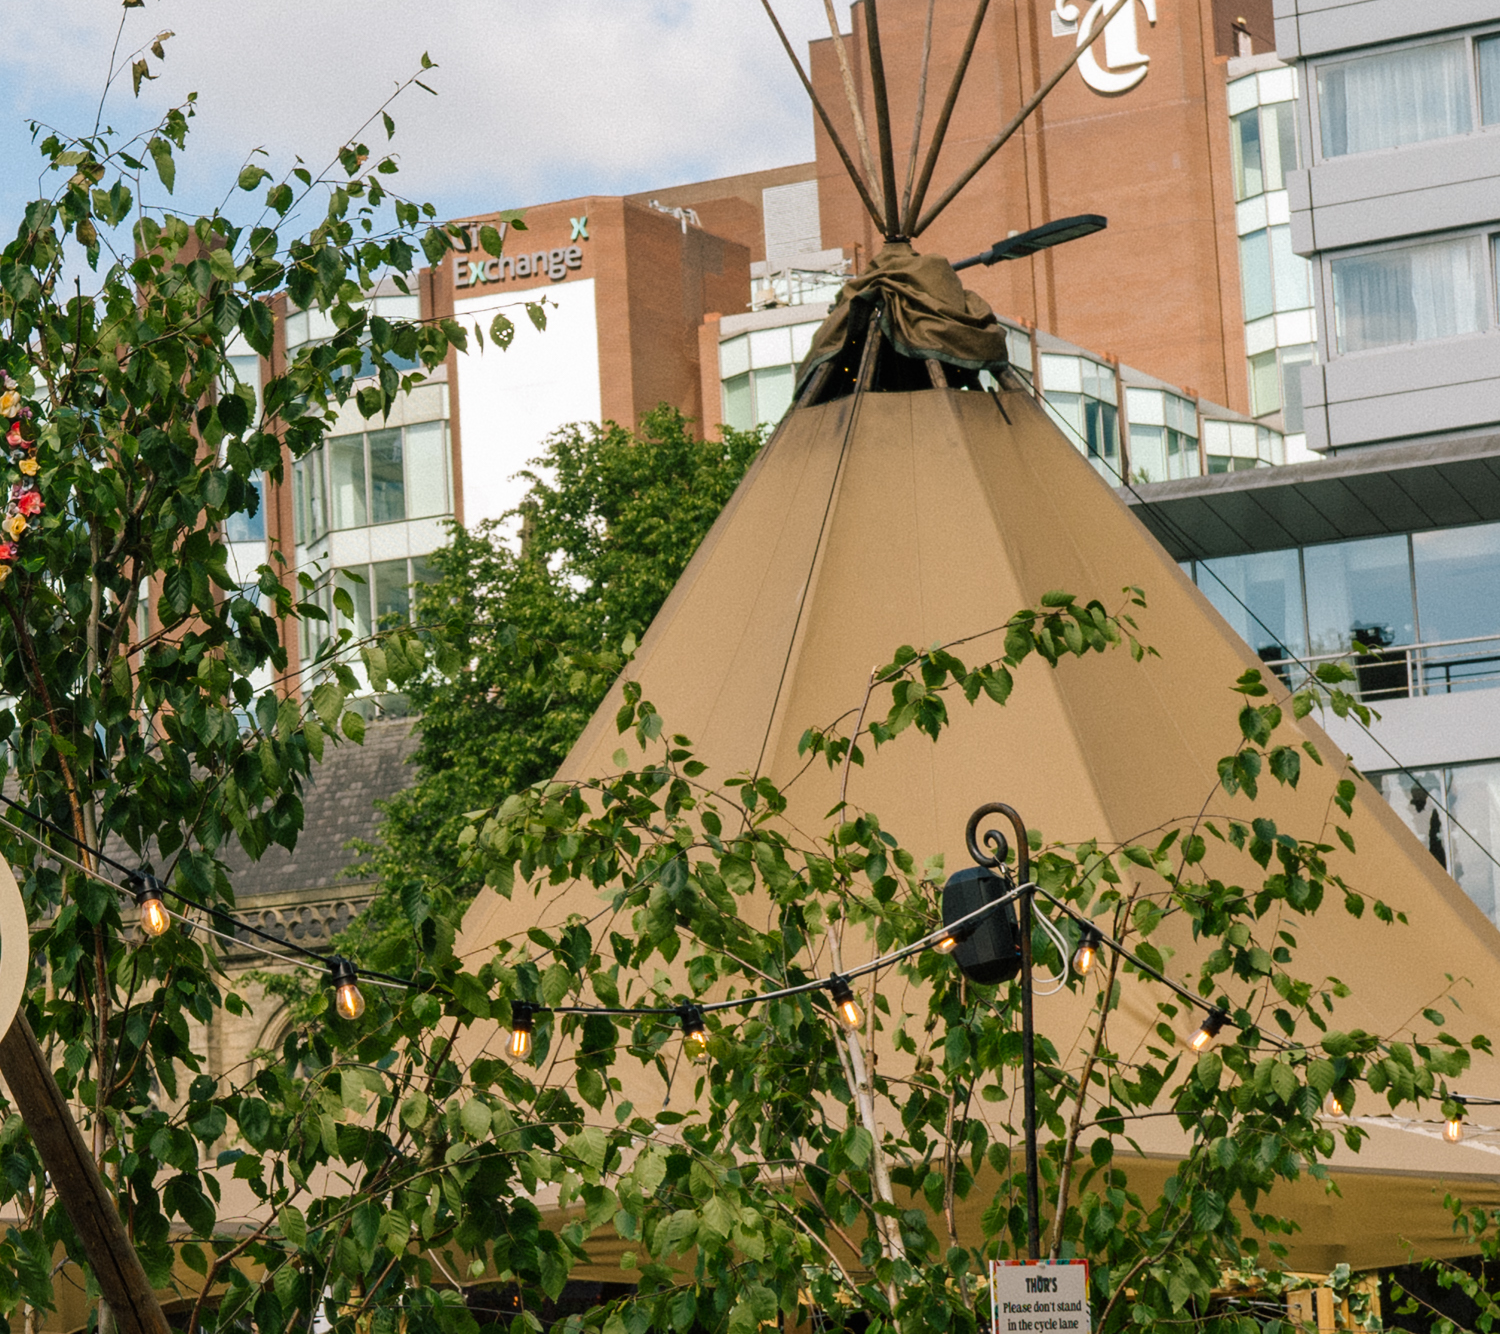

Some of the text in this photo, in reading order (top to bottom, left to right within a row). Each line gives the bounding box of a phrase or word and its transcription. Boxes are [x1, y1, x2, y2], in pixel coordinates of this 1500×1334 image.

[453, 245, 583, 287] Exchange
[1025, 1275, 1058, 1293] THOR'S
[1003, 1300, 1081, 1313] Please don't stand
[1008, 1318, 1079, 1333] in the cycle lane
